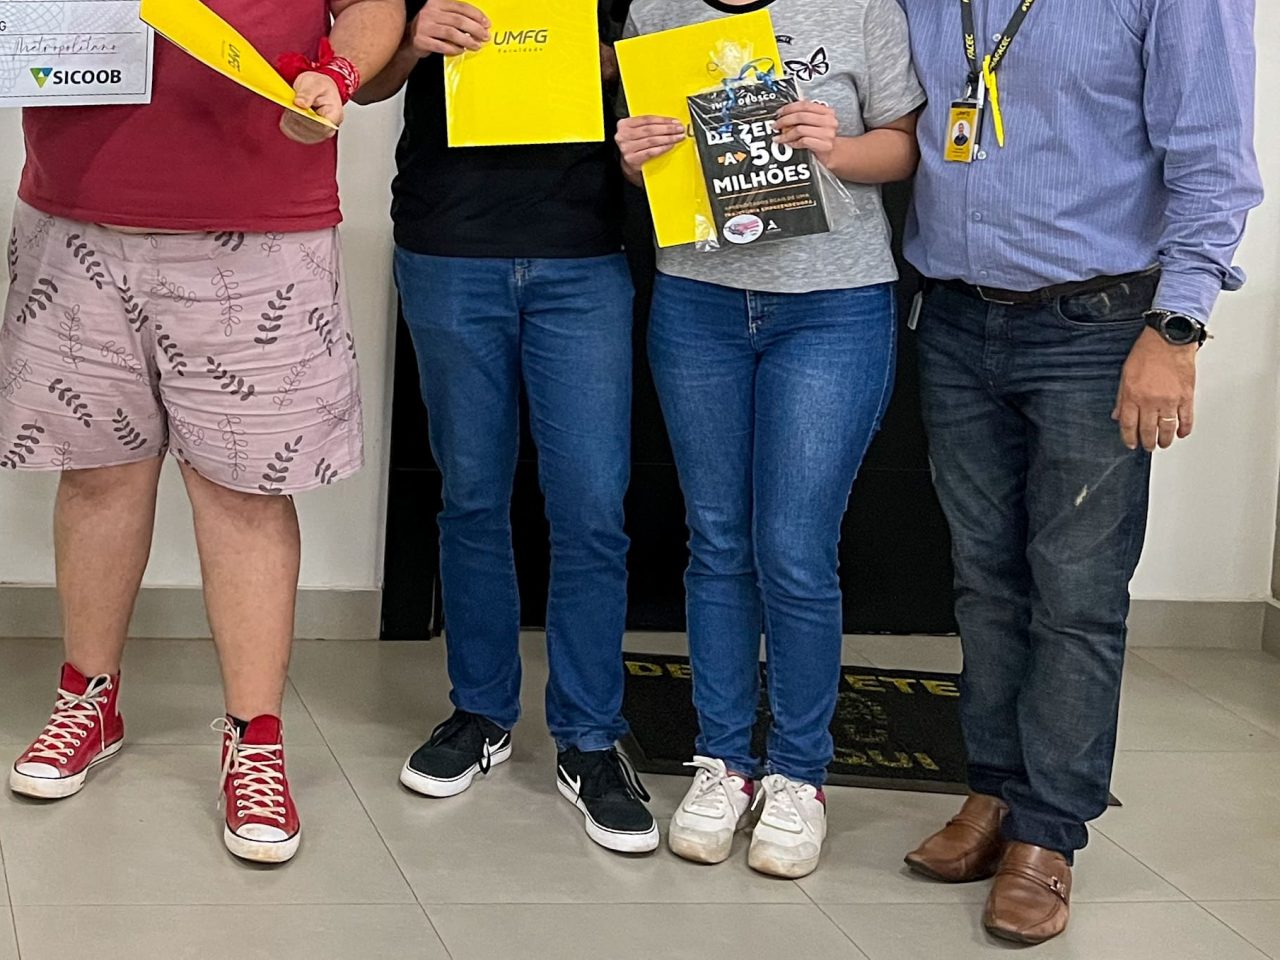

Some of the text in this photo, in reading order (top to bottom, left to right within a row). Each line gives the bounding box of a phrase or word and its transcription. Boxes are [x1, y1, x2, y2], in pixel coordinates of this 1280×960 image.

[494, 29, 548, 46] UMFG
[52, 69, 122, 85] SICOOB
[738, 120, 780, 144] ZER
[723, 142, 794, 166] A 50
[713, 163, 811, 194] MILHÕES
